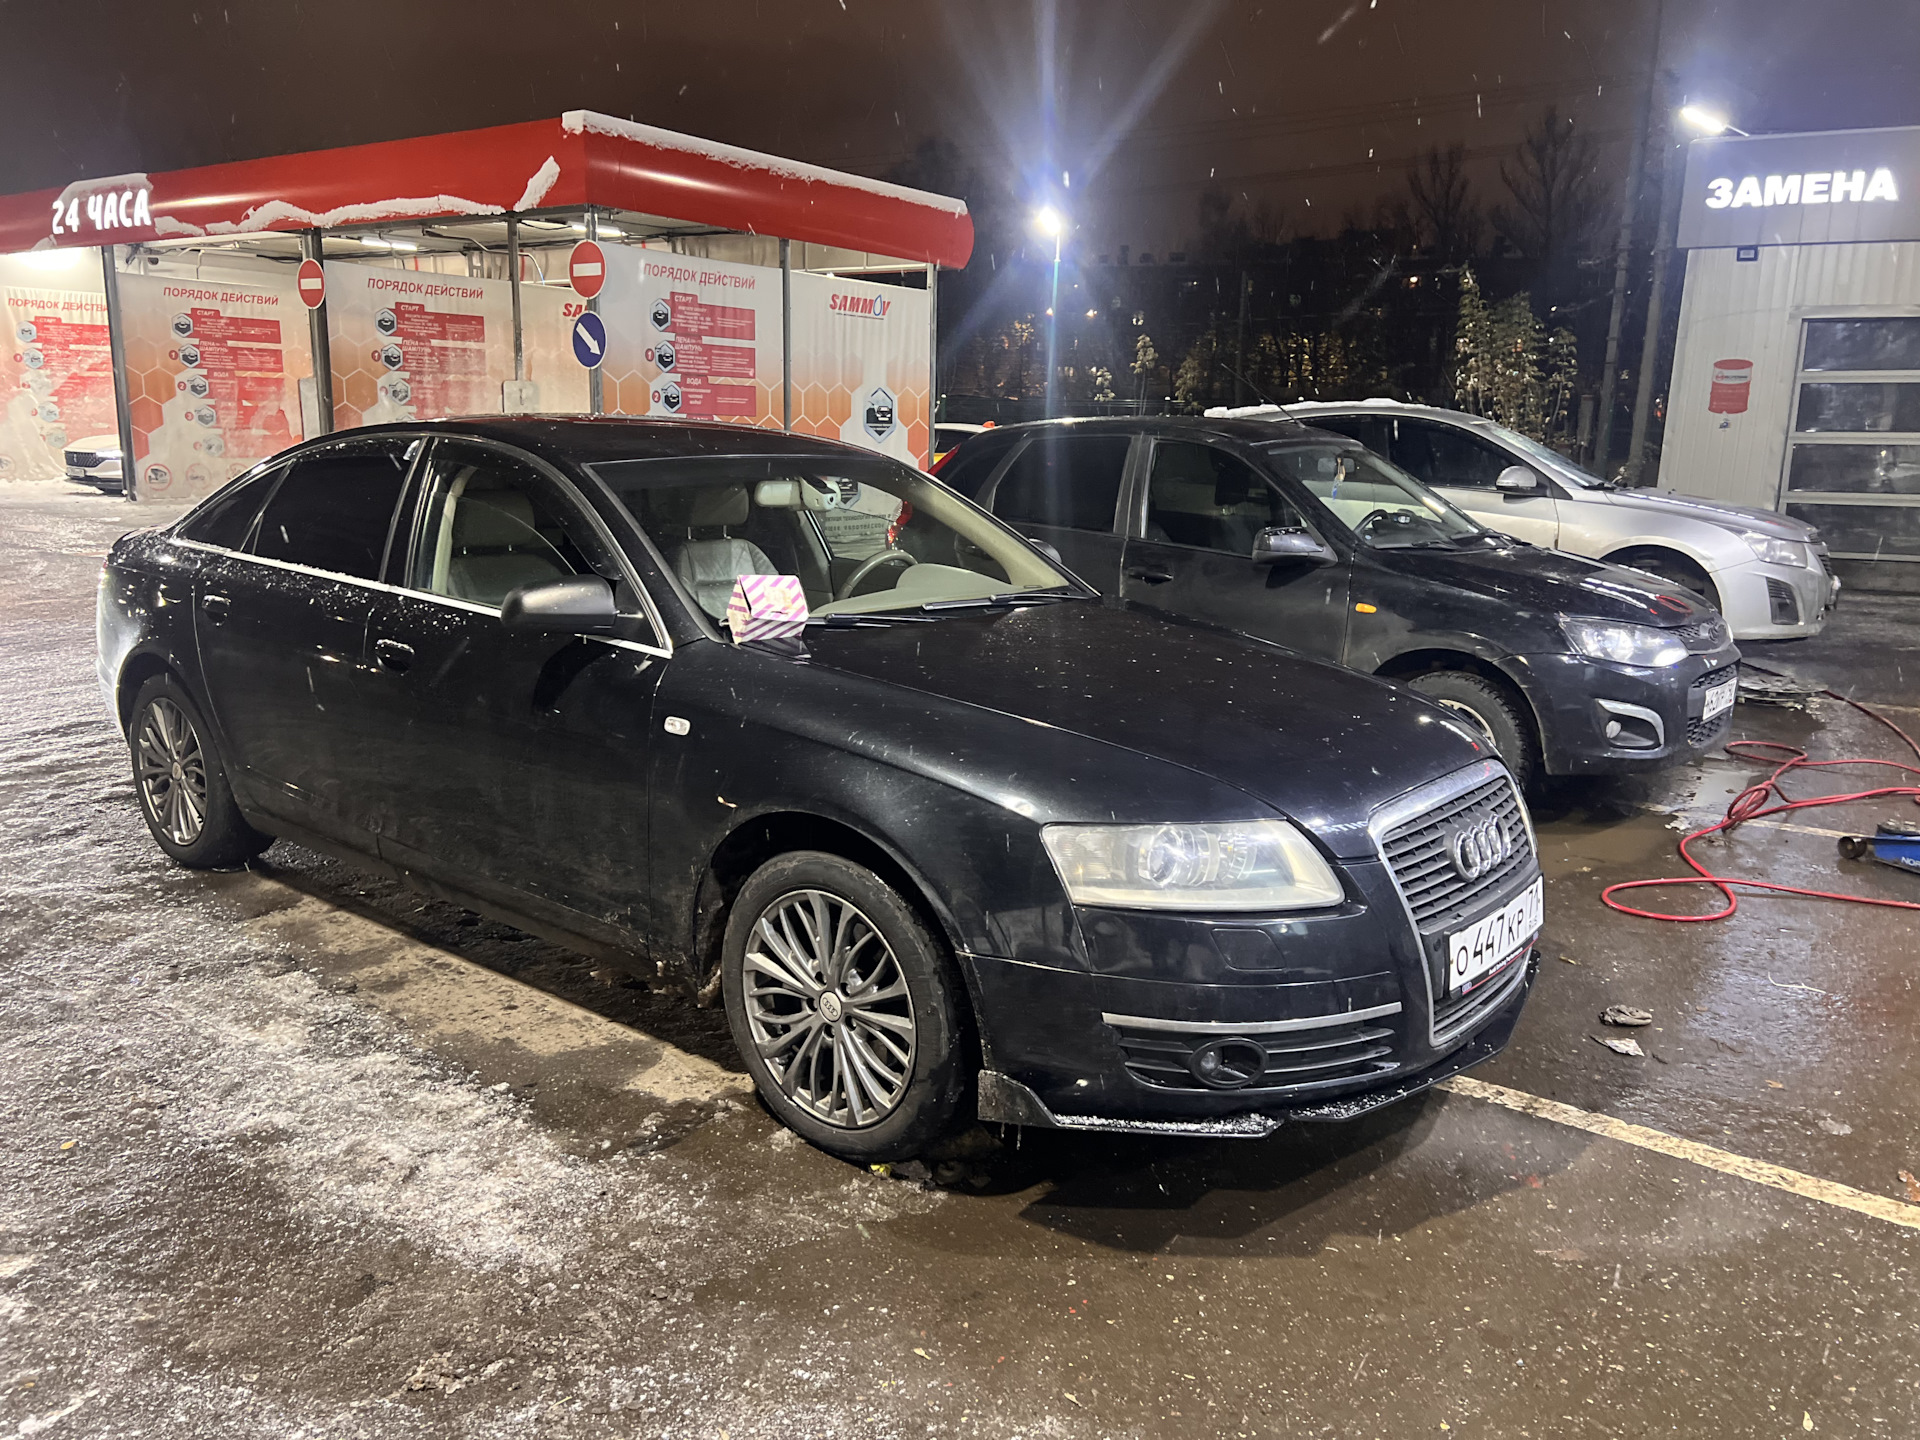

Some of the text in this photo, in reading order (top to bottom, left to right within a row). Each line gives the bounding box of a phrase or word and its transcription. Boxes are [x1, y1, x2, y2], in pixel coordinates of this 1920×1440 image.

[1705, 167, 1899, 209] ЗАМЕНА
[52, 188, 152, 235] 24 ЧАСА
[643, 262, 756, 290] ПОРЯДОК ДЕЙСТВИЙ
[163, 286, 279, 306] ПОРЯДОК ДЕЙСТВИЙ
[367, 277, 484, 300] ПОРЯДОК ДЕЙСТВИЙ
[8, 297, 60, 310] ПОРЯДОК
[400, 304, 420, 312] СТАРТ
[674, 295, 693, 304] СТАРТ
[562, 302, 588, 318] SA
[686, 377, 702, 386] ВОДА
